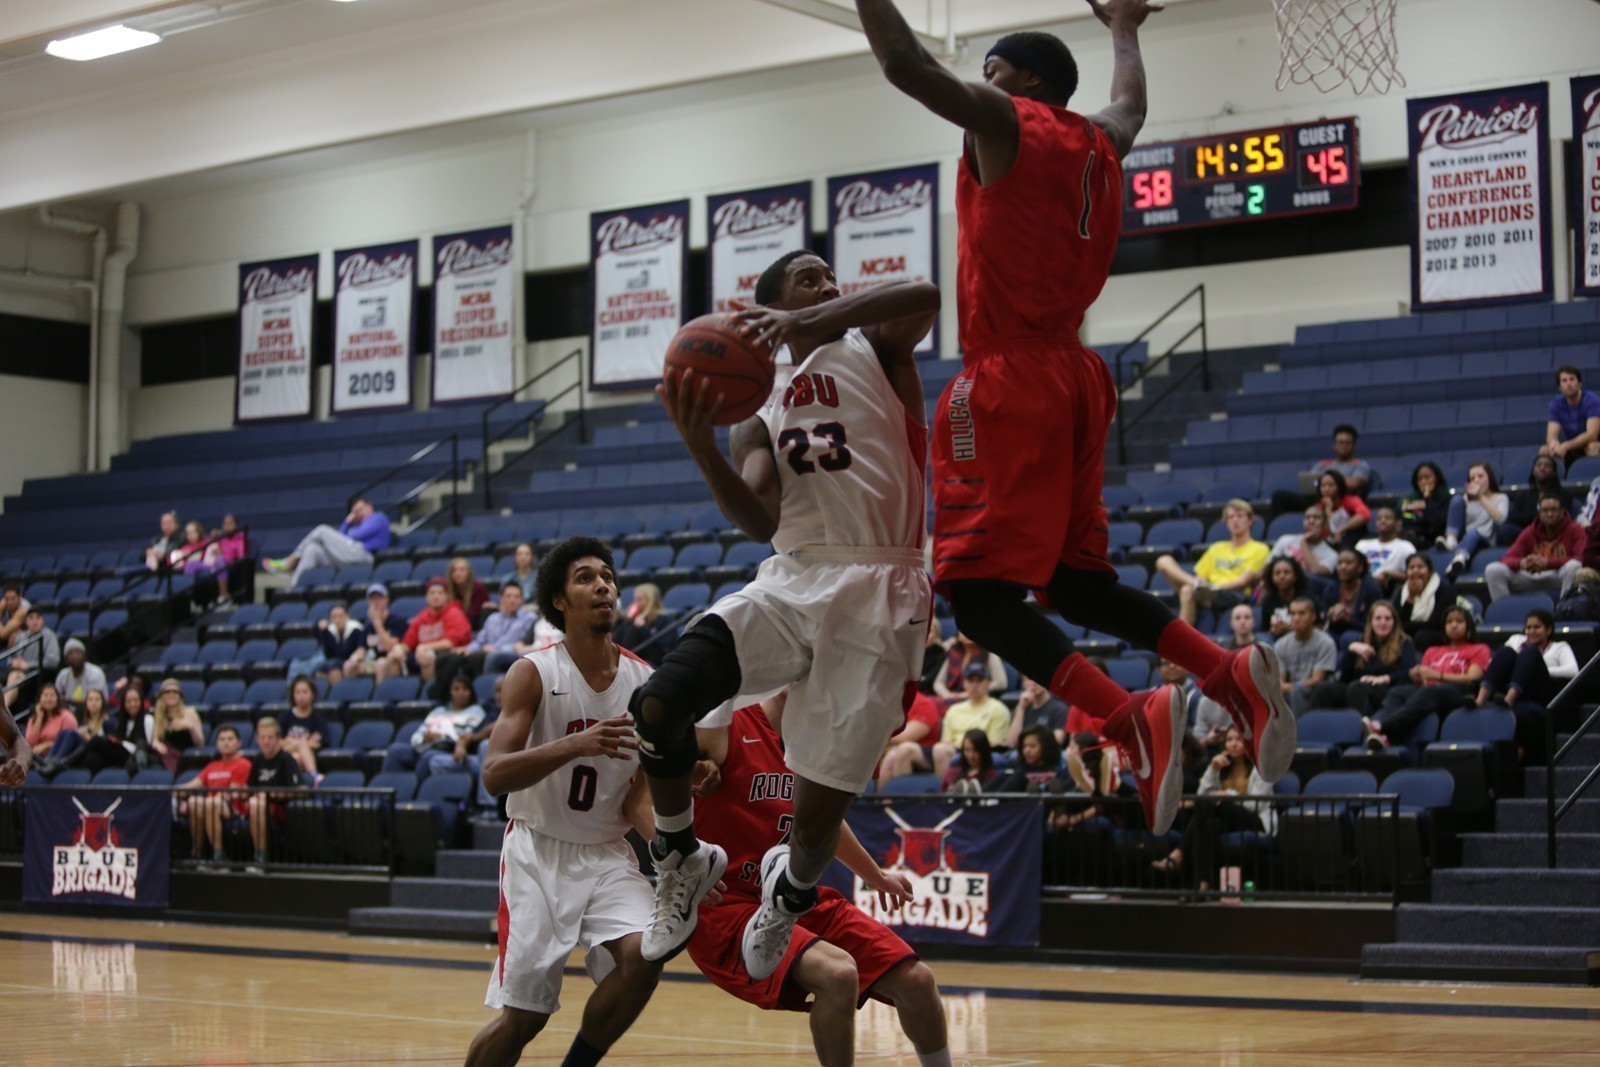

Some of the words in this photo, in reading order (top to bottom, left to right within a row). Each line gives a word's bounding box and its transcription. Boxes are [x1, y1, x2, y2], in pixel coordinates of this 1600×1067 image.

[1298, 124, 1346, 146] GUEST
[1418, 102, 1537, 150] Patriots
[1196, 134, 1285, 179] 14:55
[1306, 147, 1348, 185] 45
[1458, 155, 1485, 166] CROSS
[1488, 150, 1527, 163] COUNTRY
[1133, 169, 1172, 209] 58
[1431, 165, 1527, 190] HEARTLAND
[835, 179, 932, 222] Patriots
[1078, 150, 1092, 240] 1
[1205, 192, 1244, 210] PERIOD
[1247, 184, 1265, 215] 2
[1293, 190, 1331, 208] BONUS
[1427, 184, 1532, 209] CONFERENCE
[713, 198, 804, 239] Patriots
[1142, 208, 1179, 226] BONUS
[1426, 203, 1535, 231] CHAMPIONS
[597, 215, 682, 255] Patriots
[1425, 237, 1457, 251] 2007
[1465, 232, 1496, 248] 2010
[1503, 229, 1534, 244] 2011
[338, 253, 413, 291] Patriots
[438, 238, 513, 278] Patriots
[860, 256, 905, 276] NCAA
[1426, 257, 1457, 272] 2012
[1463, 254, 1496, 270] 2013
[243, 267, 313, 304] Patriots
[599, 304, 675, 326] CHAMPIONS
[348, 370, 396, 396] 2009
[777, 421, 852, 477] 23
[567, 764, 598, 812] 0
[748, 772, 795, 802] ROG
[57, 850, 136, 867] BLUE
[52, 866, 137, 900] BRIGADE
